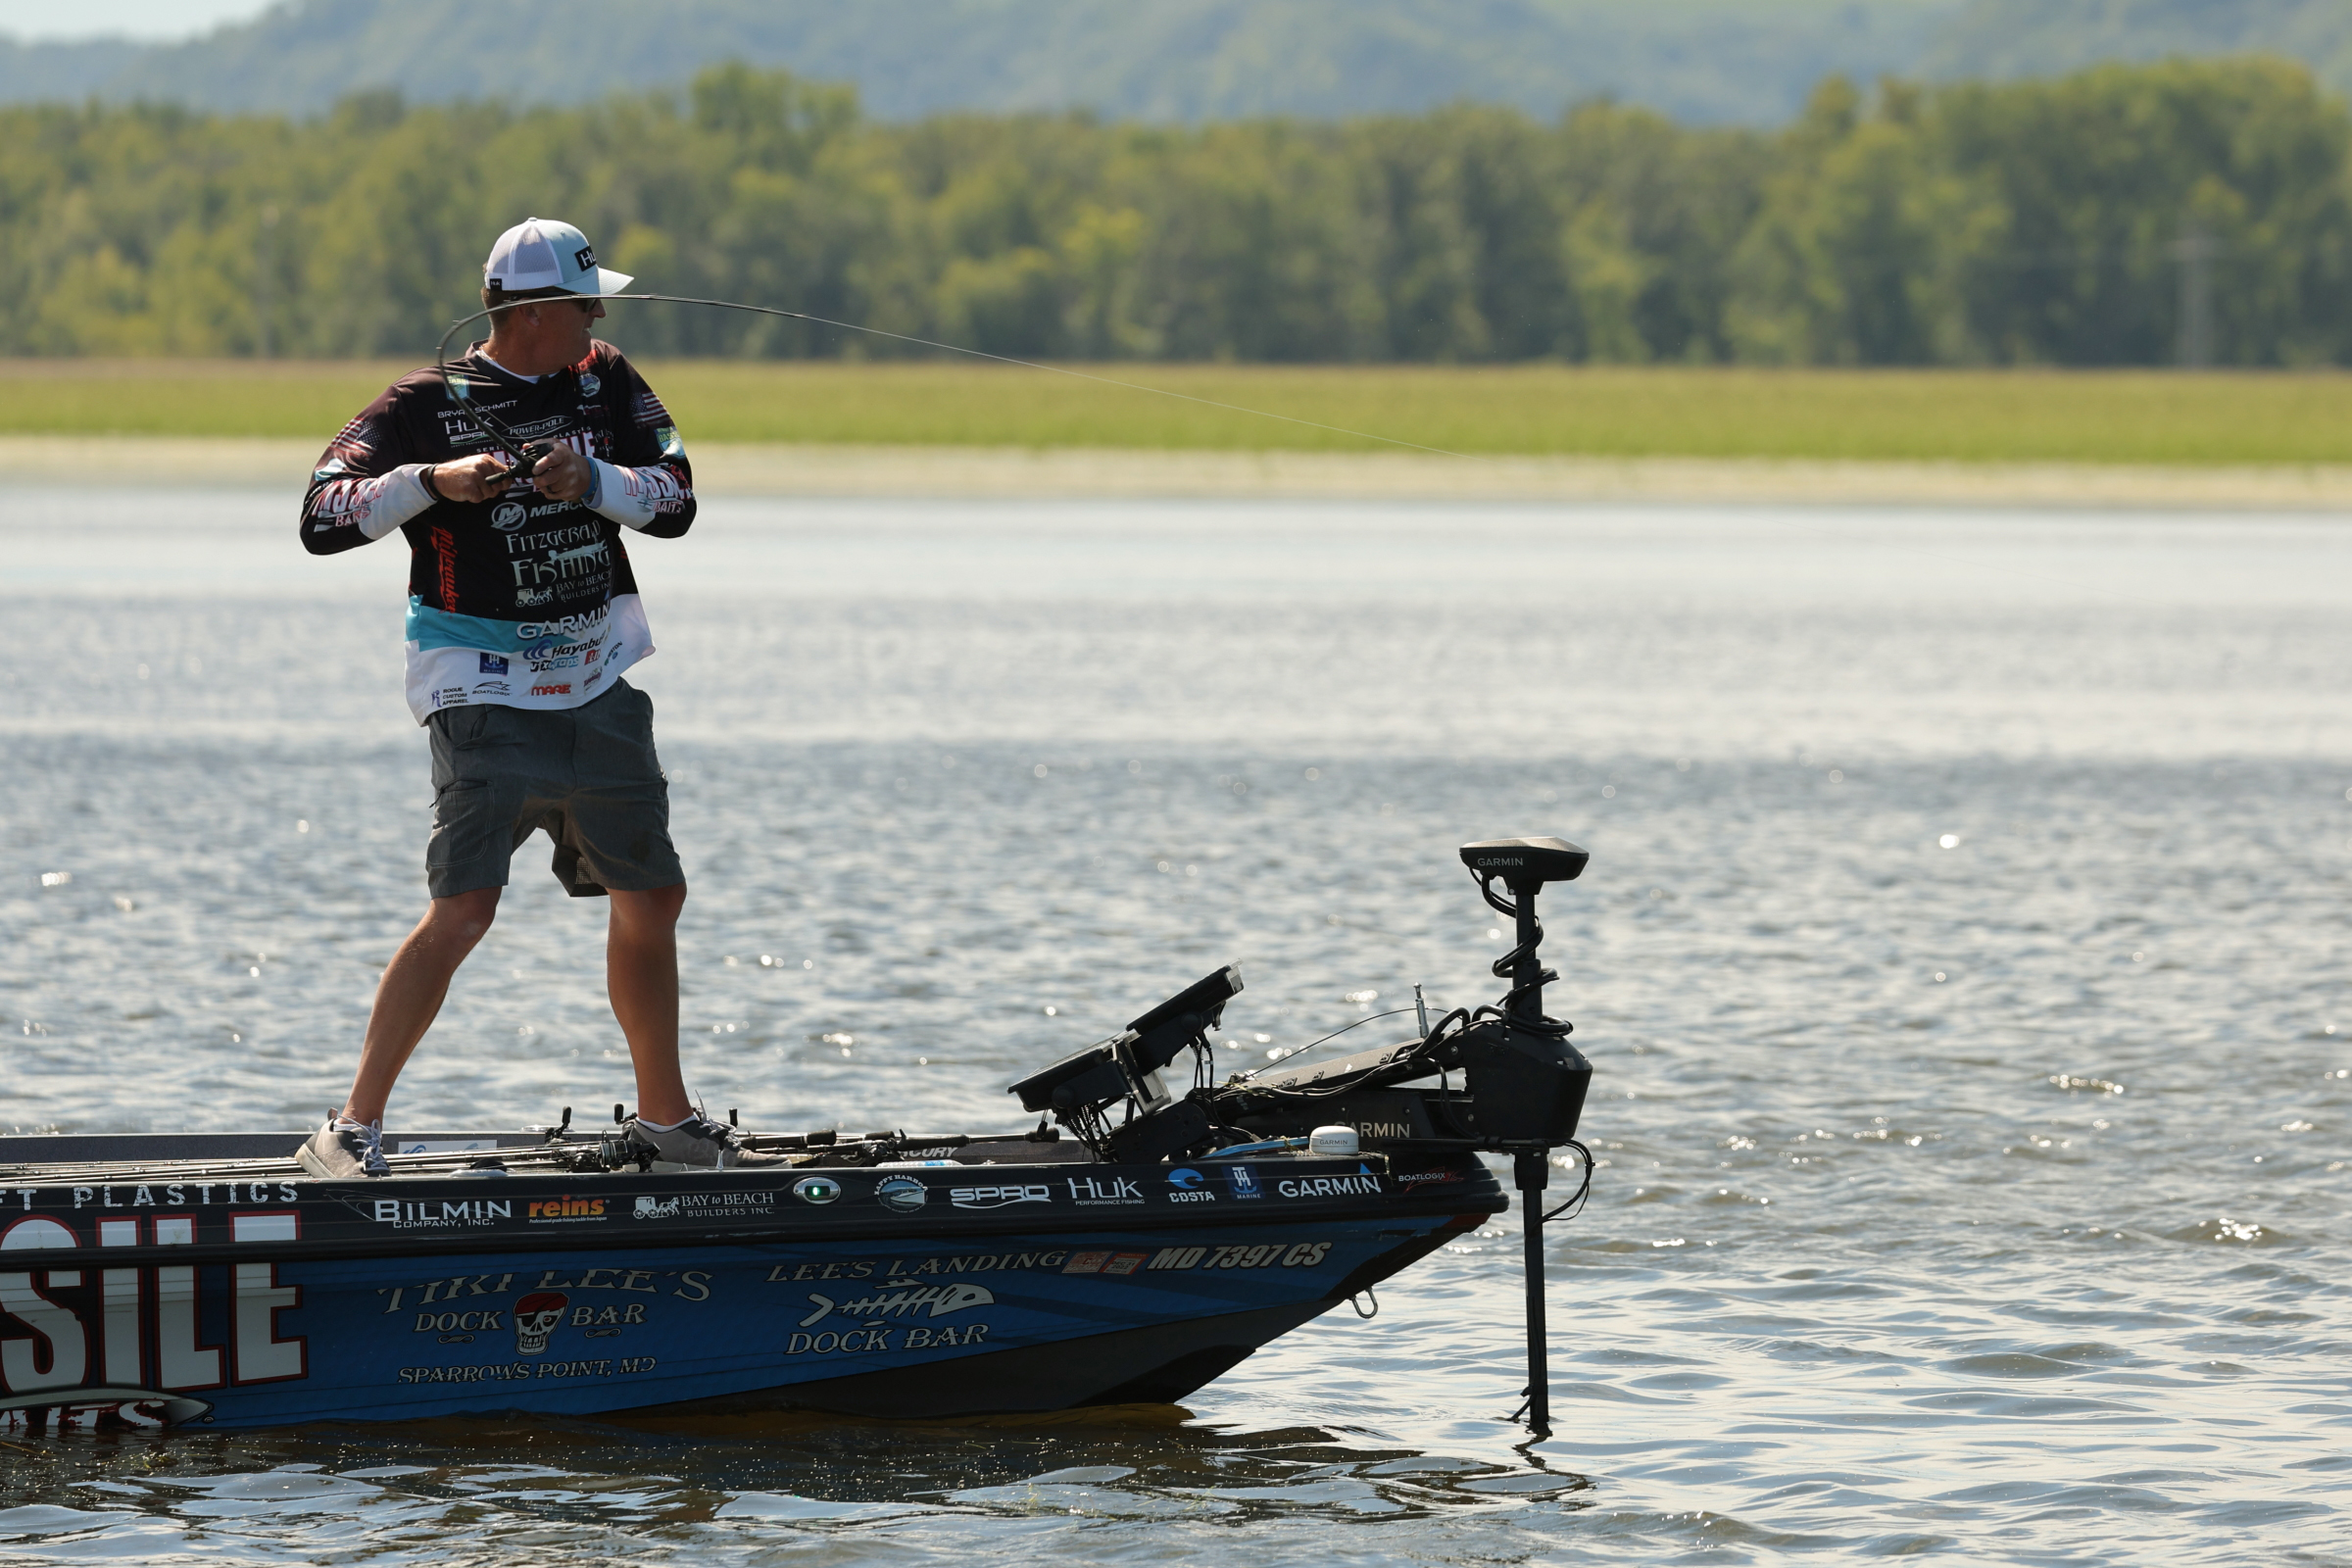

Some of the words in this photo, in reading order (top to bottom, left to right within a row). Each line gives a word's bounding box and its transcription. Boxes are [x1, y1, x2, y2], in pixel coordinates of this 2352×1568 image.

[579, 250, 597, 268] Hu
[474, 400, 517, 414] SCHMITT
[445, 416, 494, 435] Huk
[509, 416, 564, 436] POWER-POLE
[476, 443, 518, 453] SERIS
[530, 501, 583, 517] MERC
[652, 501, 684, 514] BAITS
[511, 549, 611, 586] FISHING
[556, 580, 576, 593] BAY
[561, 586, 600, 602] BUILDERS
[516, 603, 610, 640] GARMIN
[1477, 858, 1524, 866] GARMIN
[873, 1175, 894, 1196] HAPPY
[1398, 1172, 1446, 1182] BOATLOGIX
[74, 1180, 299, 1209] PLASTICS
[950, 1185, 1052, 1201] SPRO
[1067, 1177, 1143, 1199] Huk
[1168, 1191, 1216, 1202] COSTA
[1278, 1176, 1382, 1198] GARMIN
[528, 1194, 605, 1217] reins
[681, 1195, 710, 1206] BAY
[711, 1195, 721, 1204] to
[723, 1192, 774, 1205] BEACH
[374, 1200, 512, 1222] BILMIN
[687, 1207, 746, 1217] BUILDERS
[751, 1206, 775, 1215] INC.
[393, 1219, 462, 1228] COMPANY,
[1147, 1248, 1206, 1270] MD
[1202, 1245, 1288, 1270] 7397
[1281, 1242, 1333, 1267] CS
[765, 1260, 877, 1282] LEE'S
[886, 1250, 1068, 1277] LANDING
[376, 1272, 515, 1314] TIKI
[532, 1268, 714, 1301] LEE'S
[415, 1310, 506, 1333] DOCK
[570, 1303, 648, 1327] BAR
[785, 1329, 895, 1354] DOCK
[904, 1324, 989, 1349] BAR
[397, 1361, 530, 1384] SPARROWS
[536, 1358, 612, 1379] POINT,
[618, 1356, 657, 1373] MD
